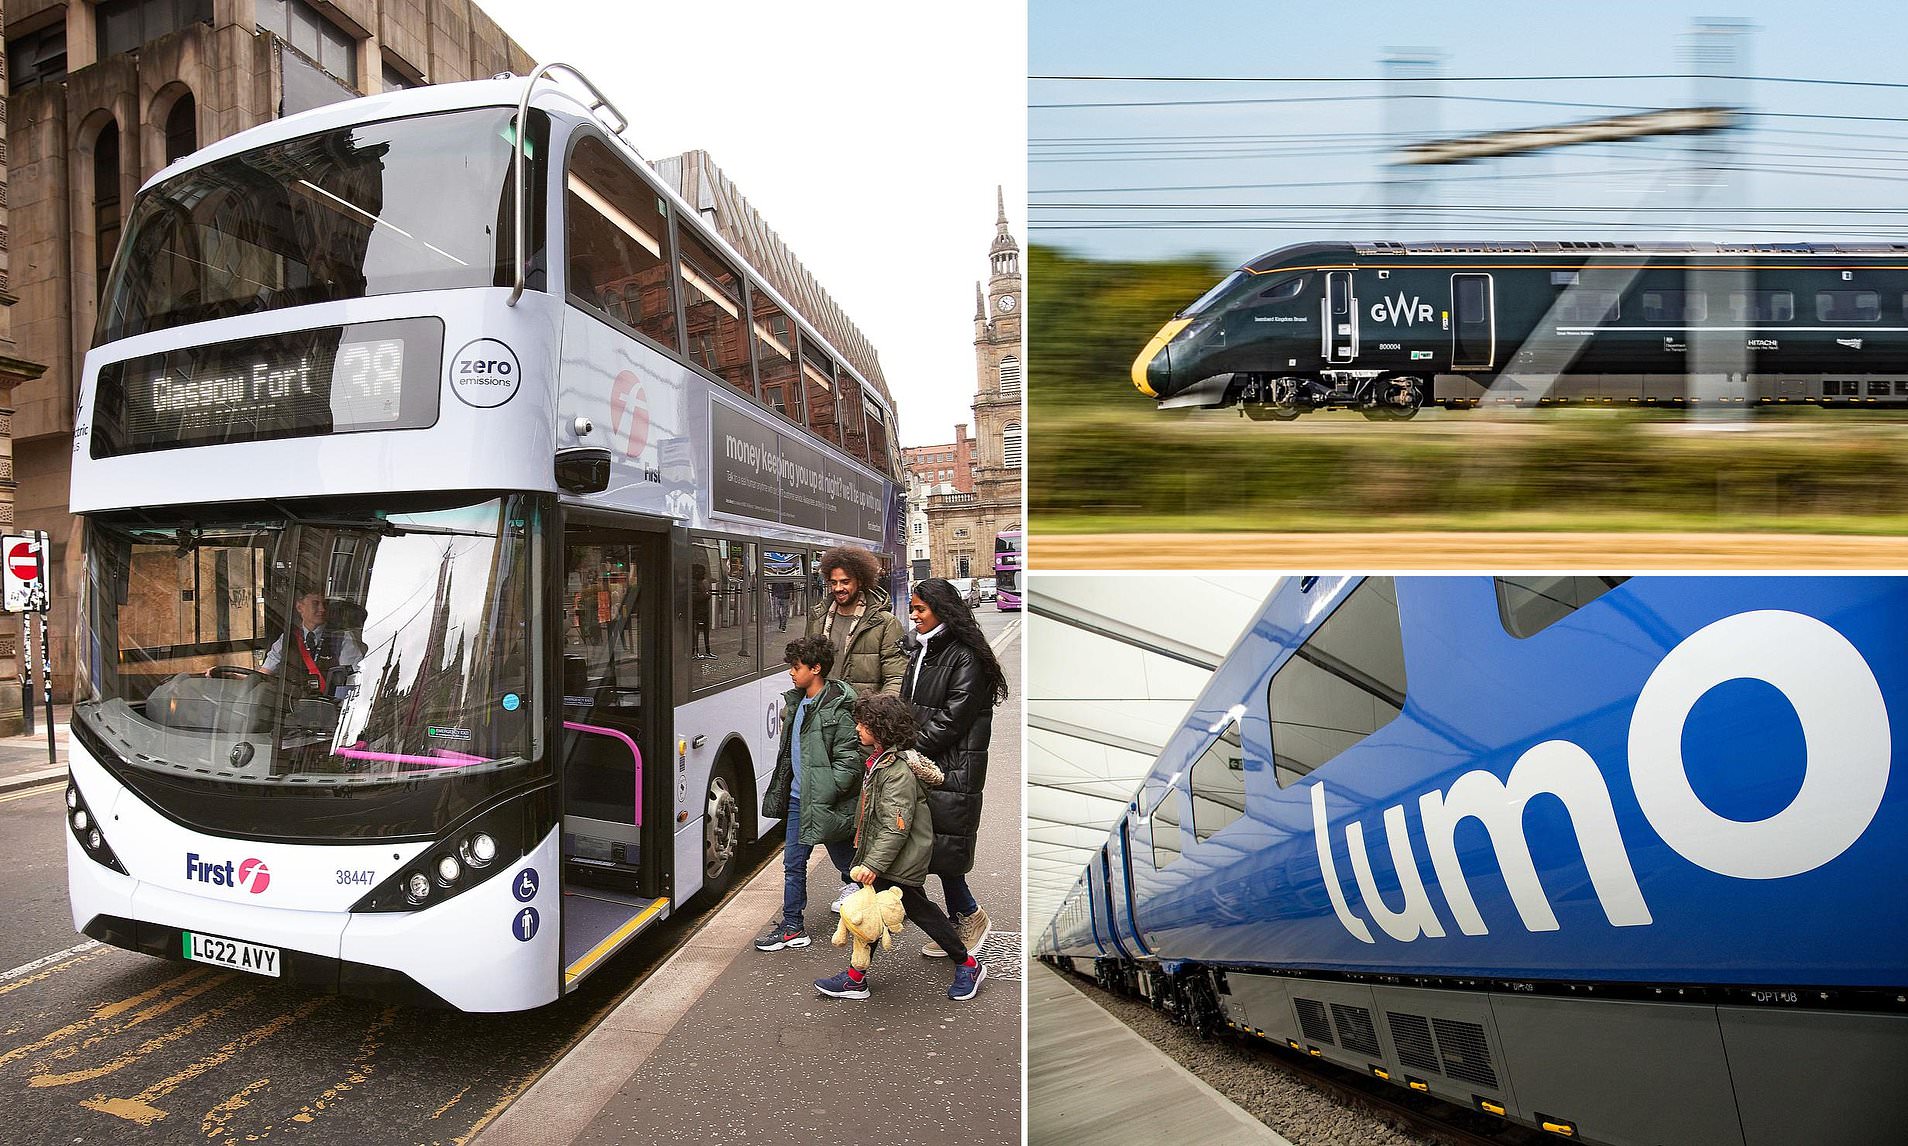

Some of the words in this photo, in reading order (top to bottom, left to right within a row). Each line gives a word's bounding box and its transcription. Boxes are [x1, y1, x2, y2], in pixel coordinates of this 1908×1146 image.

[1370, 290, 1434, 328] GWR
[153, 376, 244, 411] Glasgow
[253, 358, 311, 400] Fort
[459, 376, 511, 387] emissions
[460, 360, 512, 376] zero
[644, 462, 661, 484] First
[726, 434, 761, 474] money
[761, 442, 795, 487] keeping
[795, 463, 809, 488] you
[809, 470, 818, 494] up
[766, 700, 781, 739] Gl
[1310, 609, 1892, 944] lumo
[186, 852, 234, 887] First
[335, 869, 375, 886] 38447
[193, 936, 237, 965] LG22
[241, 946, 276, 972] AVY
